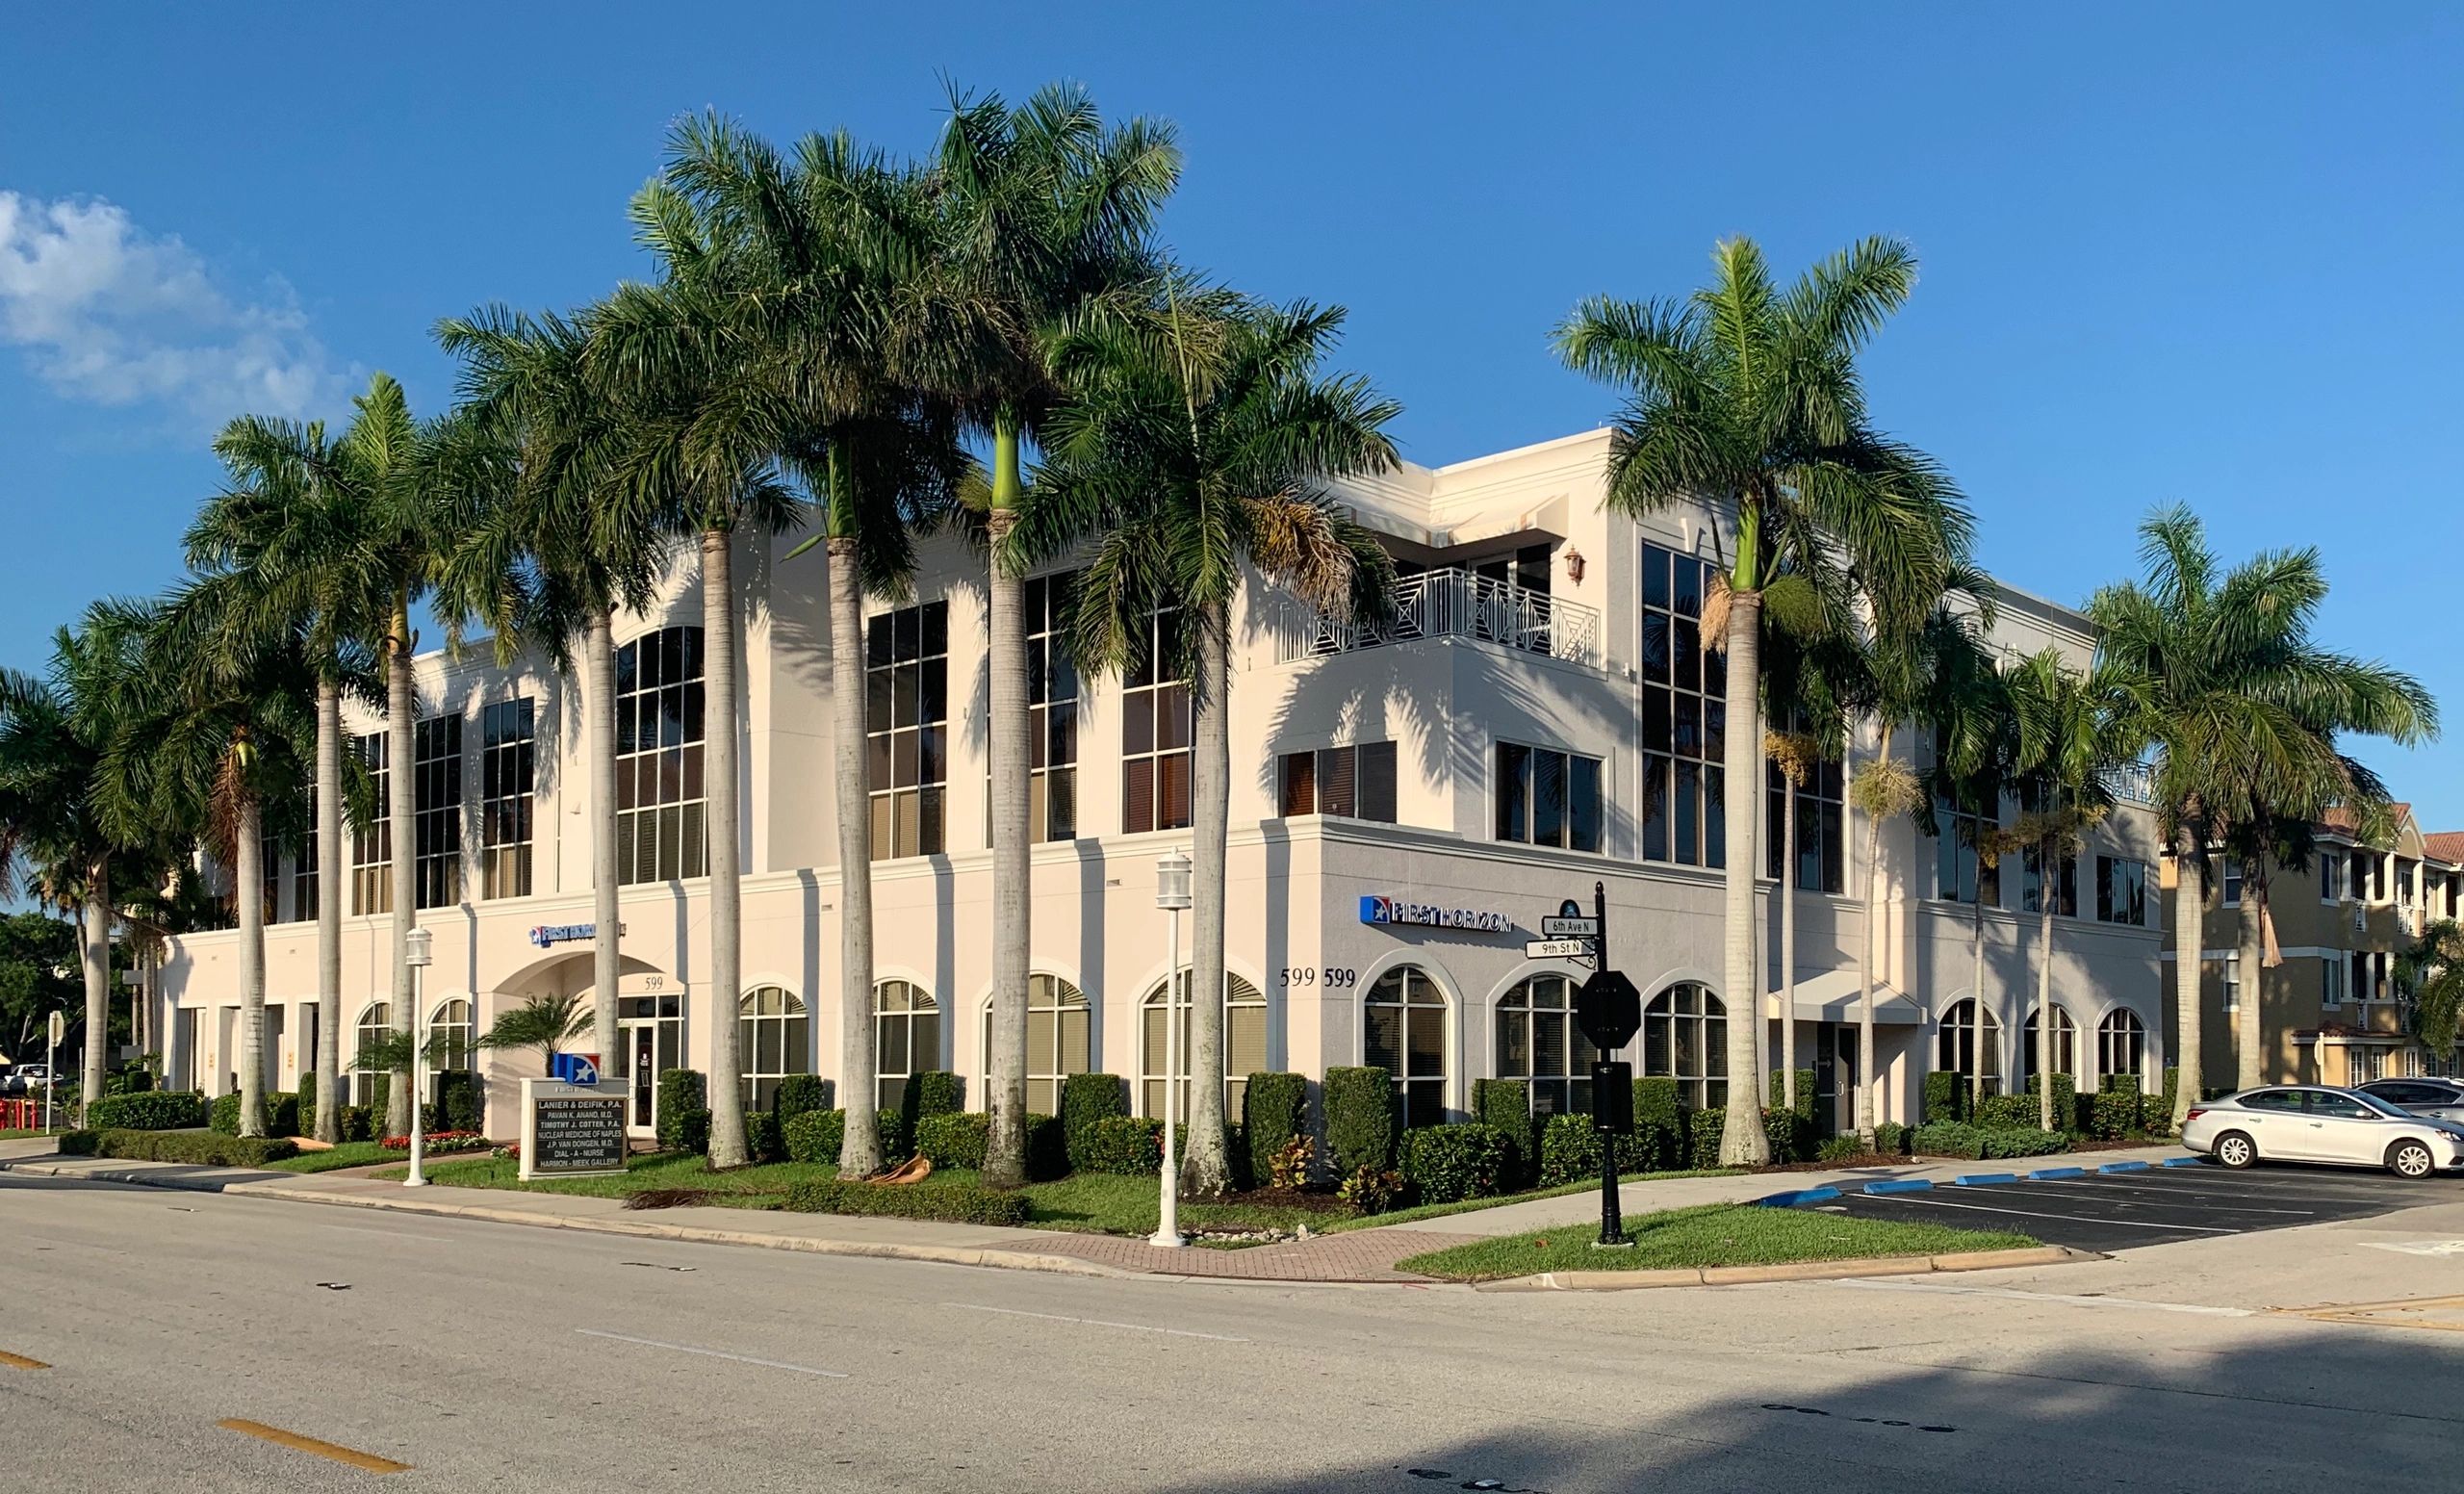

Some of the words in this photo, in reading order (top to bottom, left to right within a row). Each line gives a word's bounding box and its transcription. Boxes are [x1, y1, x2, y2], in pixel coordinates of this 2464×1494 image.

[1391, 902, 1438, 925] FIRST
[1440, 907, 1511, 932] HORIZON
[542, 926, 570, 940] FIRST
[1553, 920, 1565, 932] 6th
[1567, 921, 1581, 932] Ave
[1583, 921, 1589, 932] N
[1542, 943, 1557, 954] 9th
[1560, 942, 1570, 954] St
[1573, 942, 1579, 953] N
[645, 976, 662, 990] 599
[1280, 966, 1315, 988] 599
[1324, 967, 1355, 988] 599
[547, 1140, 557, 1148] J.P.
